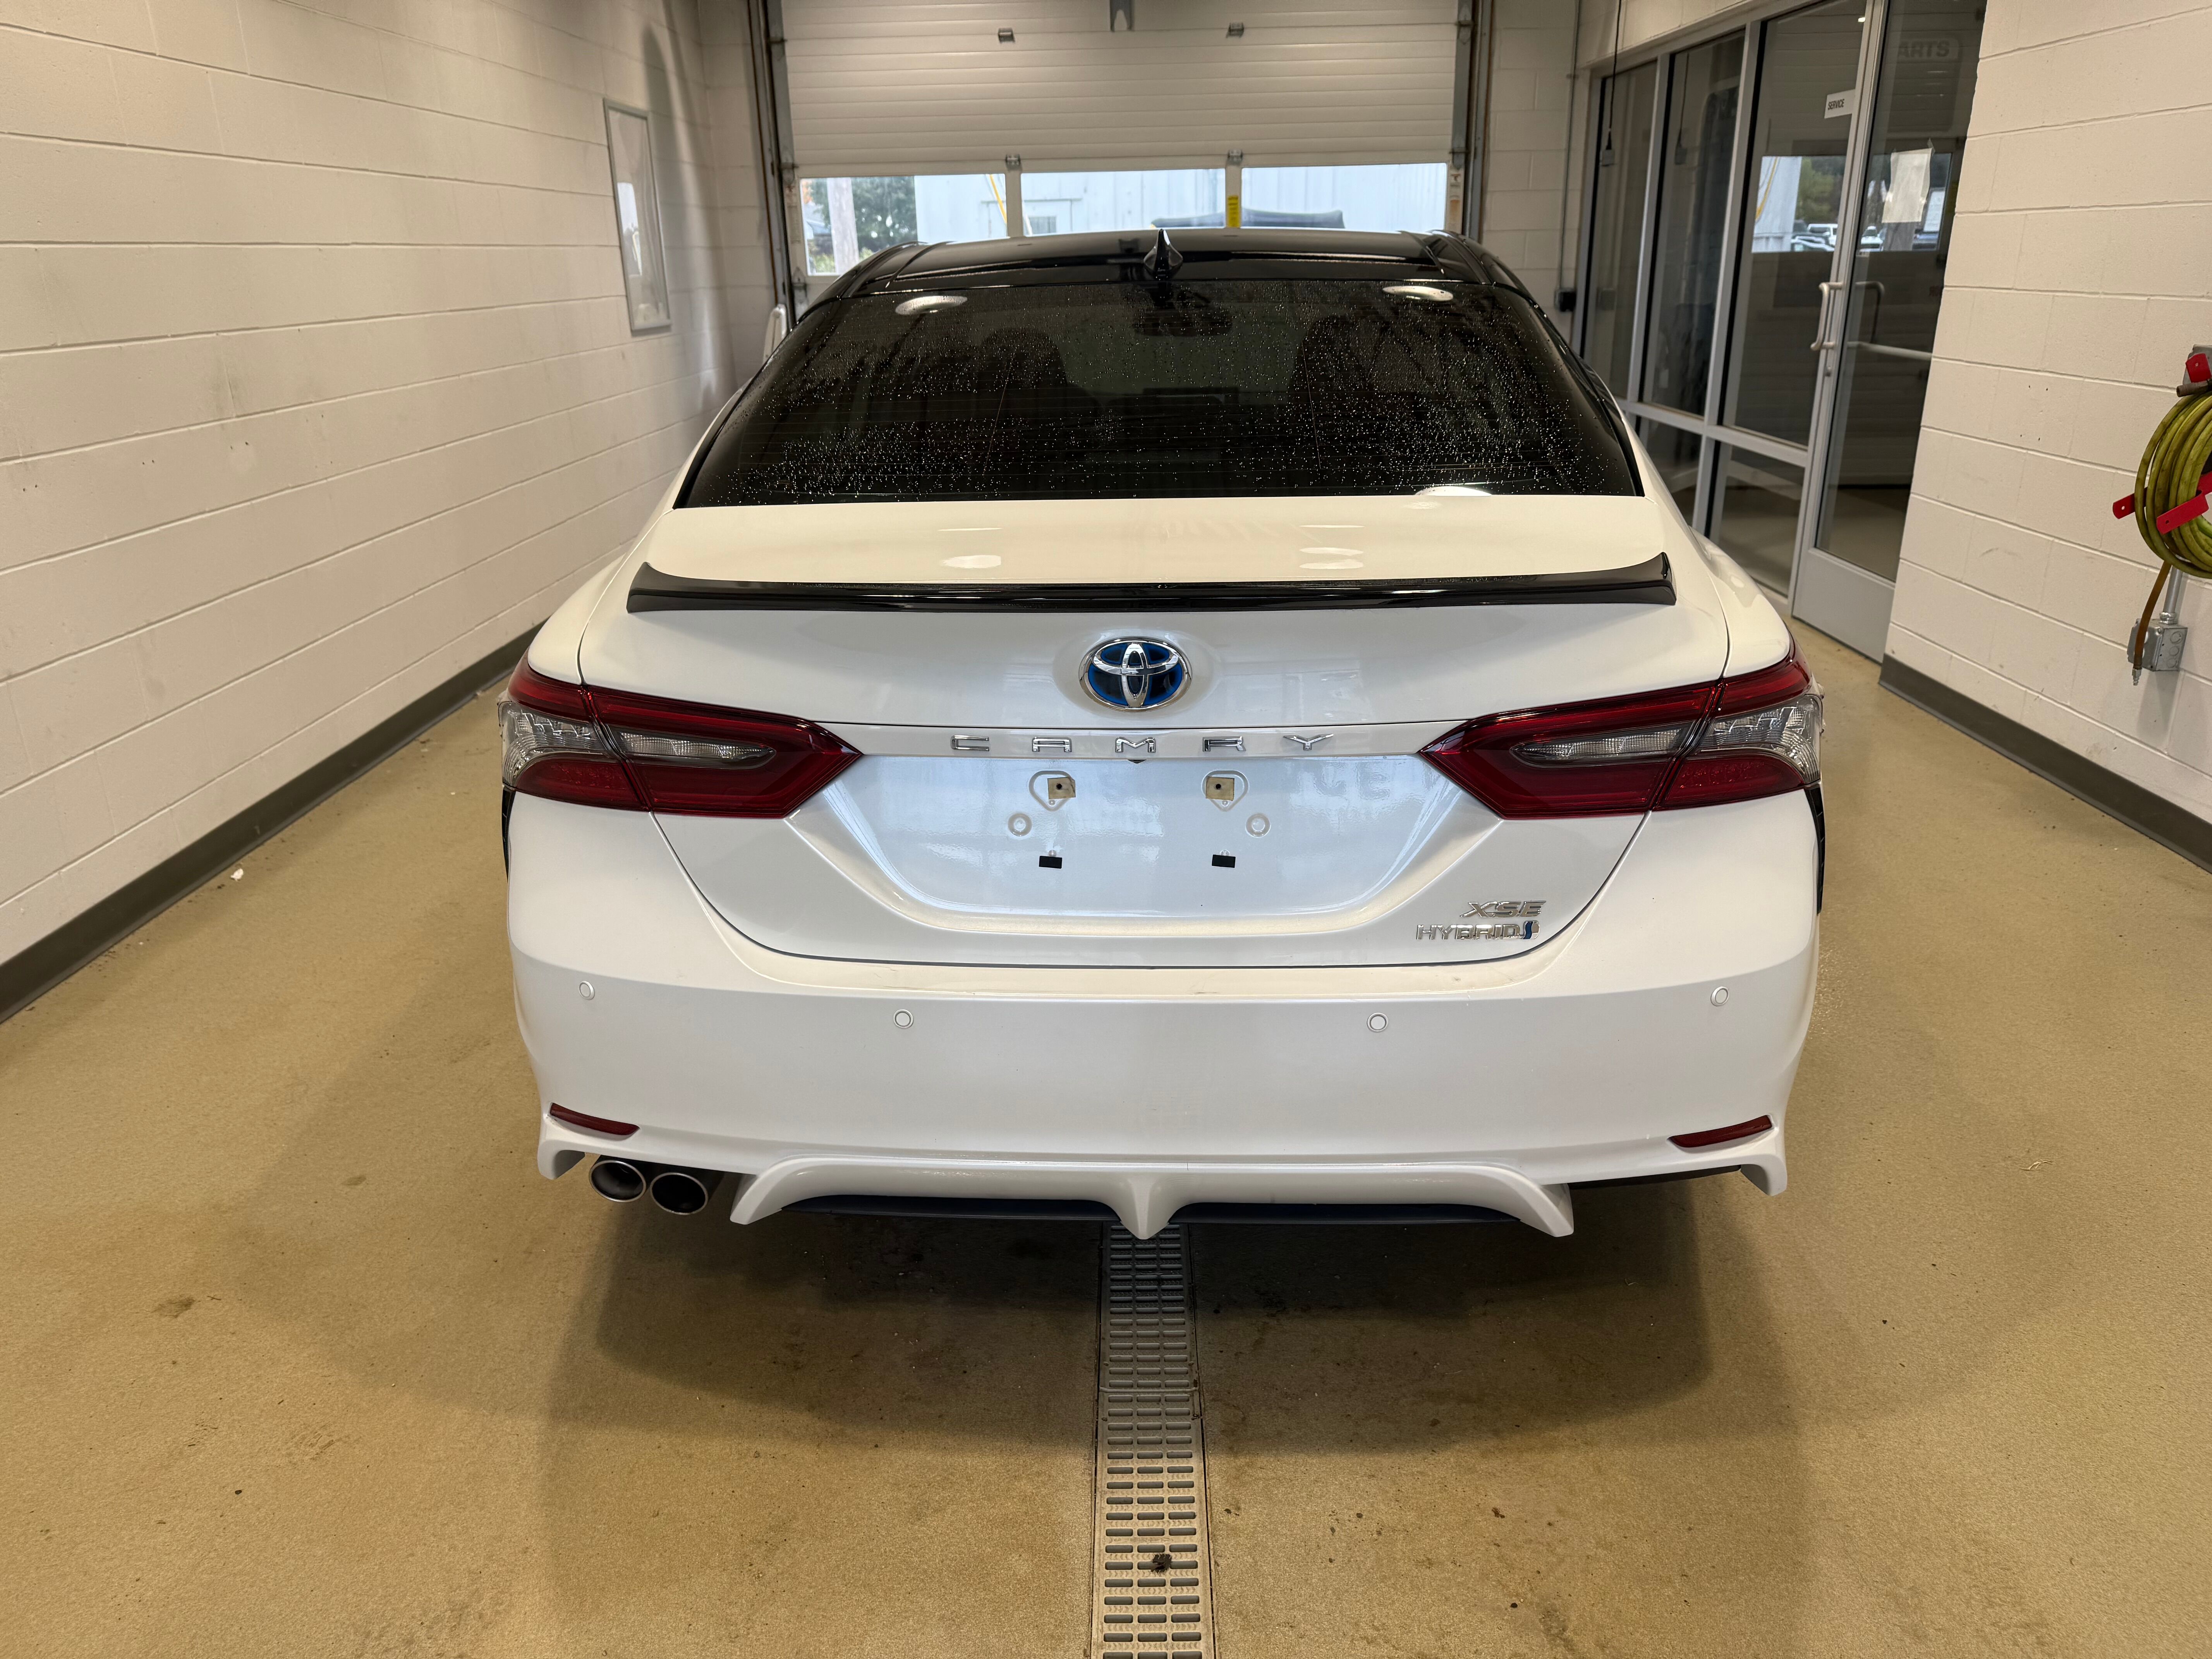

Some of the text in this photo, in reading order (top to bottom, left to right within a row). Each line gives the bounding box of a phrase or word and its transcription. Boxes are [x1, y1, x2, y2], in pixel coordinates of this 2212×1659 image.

[1898, 40, 1950, 57] ARTS
[1828, 98, 1845, 110] SERVICE
[950, 733, 1334, 754] CAMRY
[1460, 900, 1547, 918] XSE
[1416, 924, 1520, 940] HYBRID
